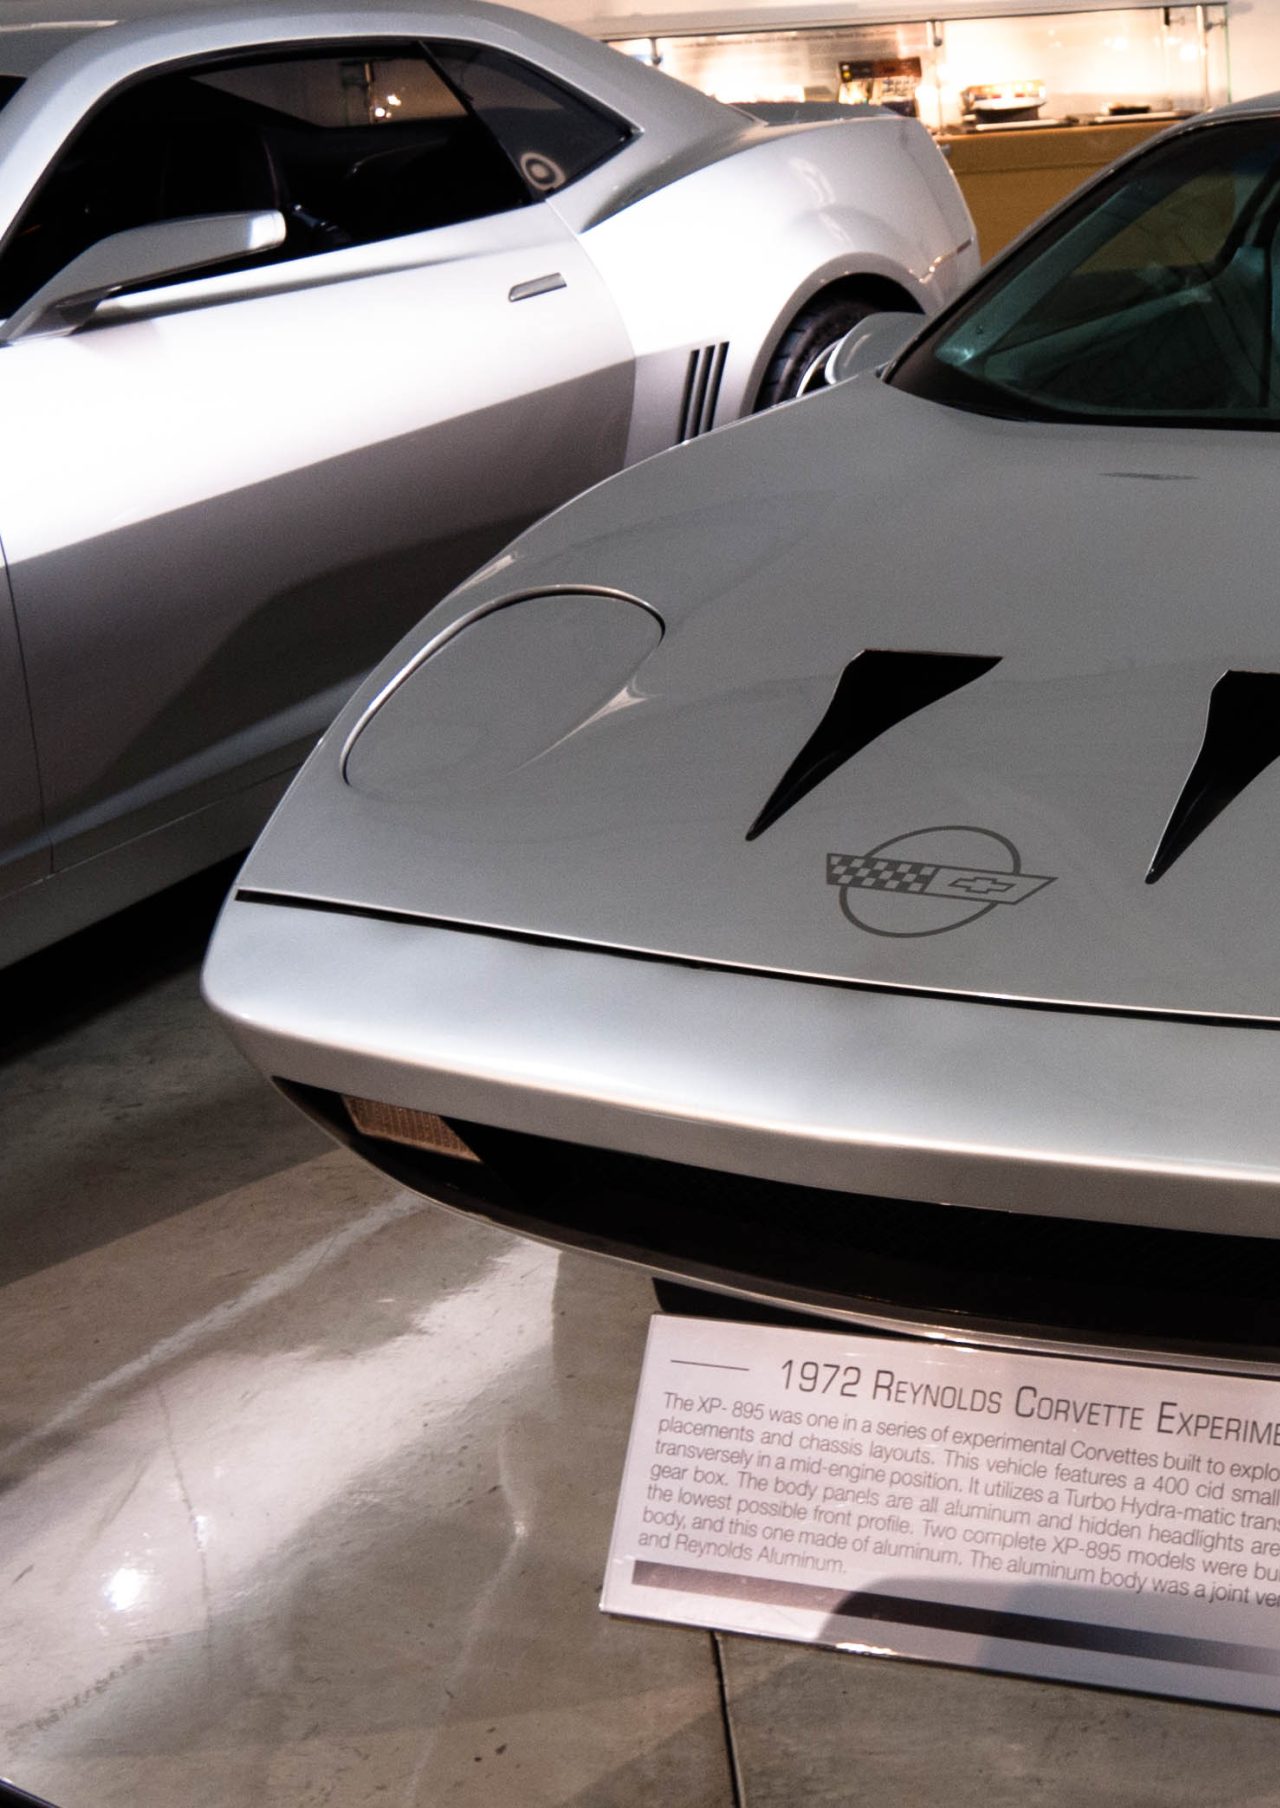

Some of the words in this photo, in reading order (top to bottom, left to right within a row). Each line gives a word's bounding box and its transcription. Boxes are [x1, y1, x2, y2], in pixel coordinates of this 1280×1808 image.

[664, 1391, 694, 1411] The
[769, 1408, 803, 1425] was
[806, 1413, 839, 1429] one
[842, 1414, 857, 1431] in
[861, 1419, 872, 1433] a
[876, 1421, 927, 1440] series
[930, 1425, 949, 1442] of
[951, 1430, 1066, 1456] experimental
[1070, 1440, 1158, 1467] Corvettes
[1162, 1451, 1201, 1472] built
[1206, 1457, 1225, 1475] to
[781, 1359, 861, 1398] 1972
[872, 1369, 1002, 1414] REYNOLDS
[1014, 1385, 1144, 1431] CORVETTE
[655, 1439, 754, 1472] transversely
[756, 1450, 771, 1468] in
[774, 1456, 785, 1470] a
[789, 1456, 886, 1483] mid-engine
[889, 1470, 962, 1492] position.
[968, 1476, 980, 1495] It
[984, 1480, 1044, 1503] utilizes
[1047, 1490, 1059, 1504] a
[1064, 1488, 1116, 1511] Turbo
[1120, 1495, 1235, 1526] Hydra-matic
[658, 1416, 754, 1443] placements
[760, 1430, 793, 1447] and
[799, 1433, 862, 1456] chassis
[869, 1440, 934, 1464] layouts.
[944, 1448, 979, 1470] This
[986, 1457, 1047, 1478] vehicle
[1054, 1463, 1127, 1488] features
[1133, 1476, 1145, 1490] a
[1152, 1475, 1189, 1496] 400
[1195, 1480, 1224, 1500] cid
[1231, 1488, 1280, 1506] small
[638, 1532, 671, 1549] and
[675, 1533, 752, 1560] Reynolds
[756, 1545, 845, 1573] Aluminum.
[642, 1505, 686, 1534] body,
[691, 1516, 725, 1533] and
[729, 1518, 757, 1537] this
[761, 1526, 795, 1542] one
[798, 1531, 847, 1550] made
[851, 1535, 870, 1552] of
[872, 1539, 961, 1565] aluminum.
[970, 1549, 1002, 1571] The
[1006, 1556, 1095, 1583] aluminum
[1099, 1566, 1147, 1594] body
[1152, 1577, 1189, 1595] was
[1194, 1583, 1206, 1598] a
[1209, 1581, 1250, 1604] joint
[647, 1483, 673, 1502] the
[677, 1487, 732, 1510] lowest
[736, 1498, 808, 1520] possible
[813, 1505, 851, 1526] front
[856, 1514, 913, 1534] profile.
[922, 1518, 957, 1540] Two
[962, 1529, 1047, 1552] complete
[1051, 1535, 1121, 1561] XP-895
[1127, 1550, 1195, 1571] models
[1201, 1559, 1248, 1578] were
[650, 1464, 688, 1481] gear
[693, 1465, 728, 1486] box.
[737, 1470, 768, 1491] The
[773, 1476, 818, 1501] body
[822, 1486, 879, 1506] panels
[885, 1494, 913, 1510] are
[919, 1496, 939, 1513] all
[944, 1499, 1031, 1525] aluminum
[1036, 1513, 1073, 1530] and
[1078, 1515, 1141, 1539] hidden
[1148, 1523, 1244, 1553] headlights
[1250, 1540, 1280, 1557] are
